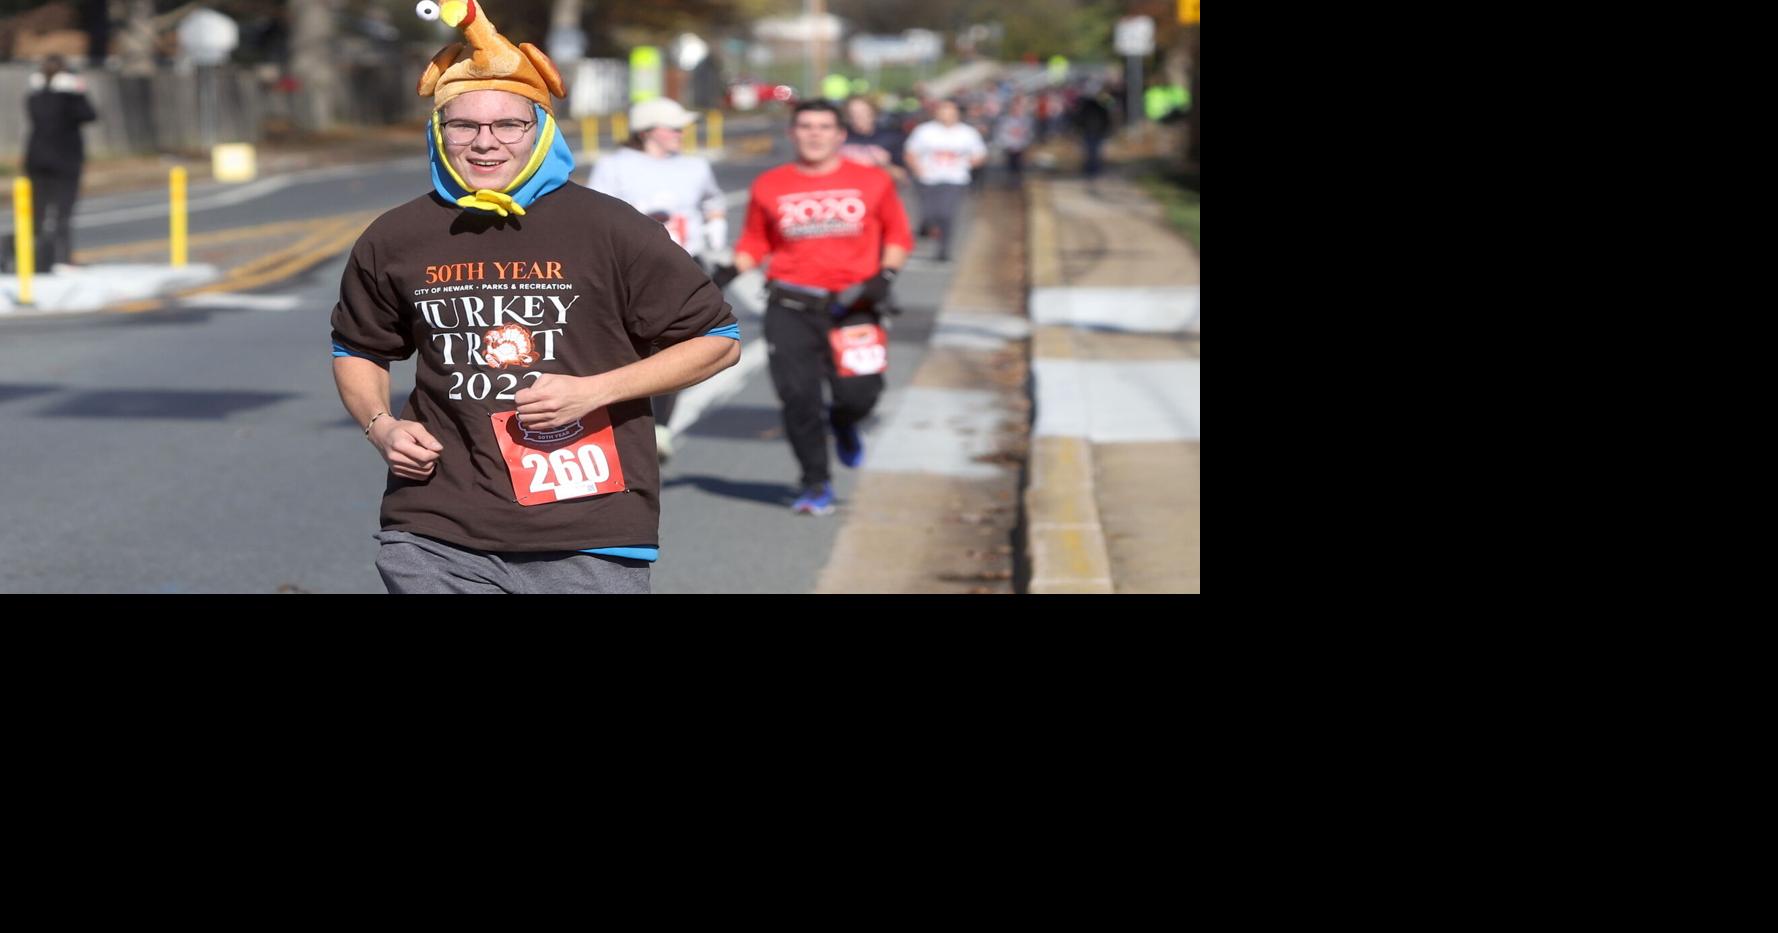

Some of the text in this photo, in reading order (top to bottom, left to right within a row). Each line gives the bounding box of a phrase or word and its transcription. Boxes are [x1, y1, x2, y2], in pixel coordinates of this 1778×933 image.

[777, 197, 866, 228] 2020
[425, 261, 564, 284] 50TH YEAR
[414, 288, 430, 296] CITY
[443, 284, 474, 293] NEWARK
[414, 295, 580, 329] TURKEY
[554, 430, 570, 439] YEAR
[521, 444, 610, 493] 260
